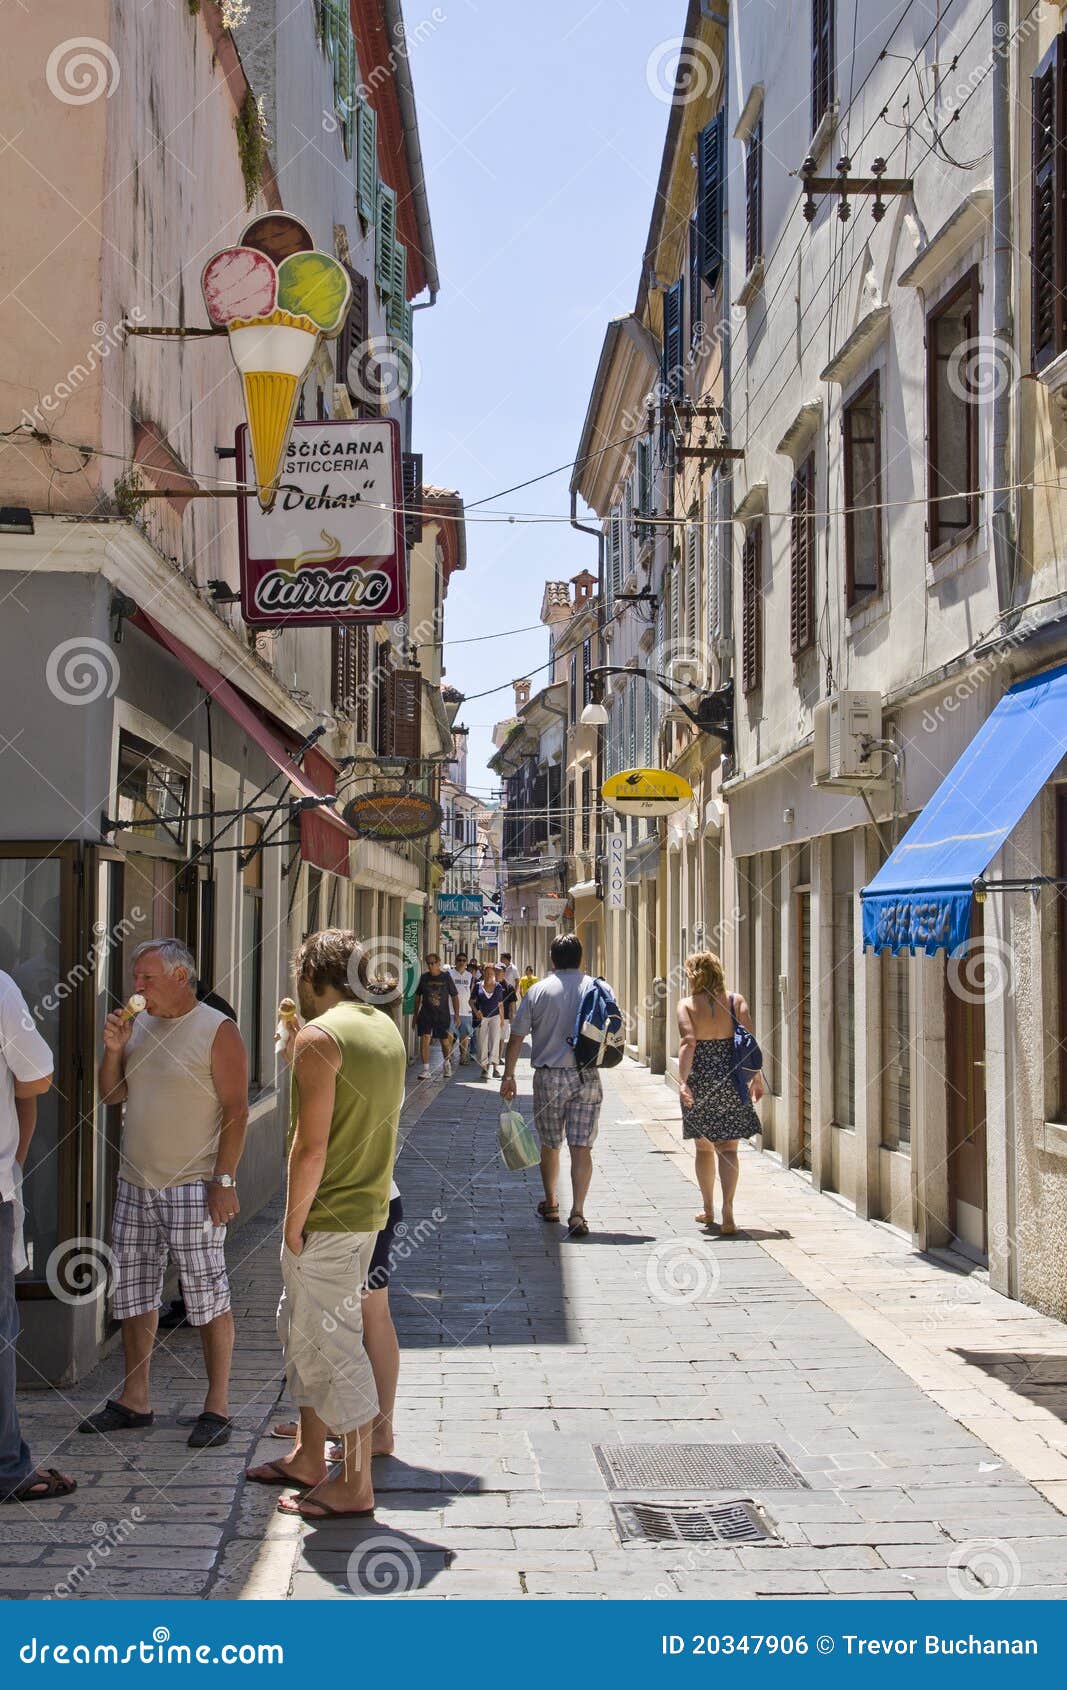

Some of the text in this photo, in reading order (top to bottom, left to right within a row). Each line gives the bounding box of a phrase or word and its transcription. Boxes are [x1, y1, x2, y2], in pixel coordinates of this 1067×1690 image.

[249, 441, 384, 457] ŠČIČARNA
[282, 459, 369, 474] STICCERIA
[258, 575, 389, 604] Carraro
